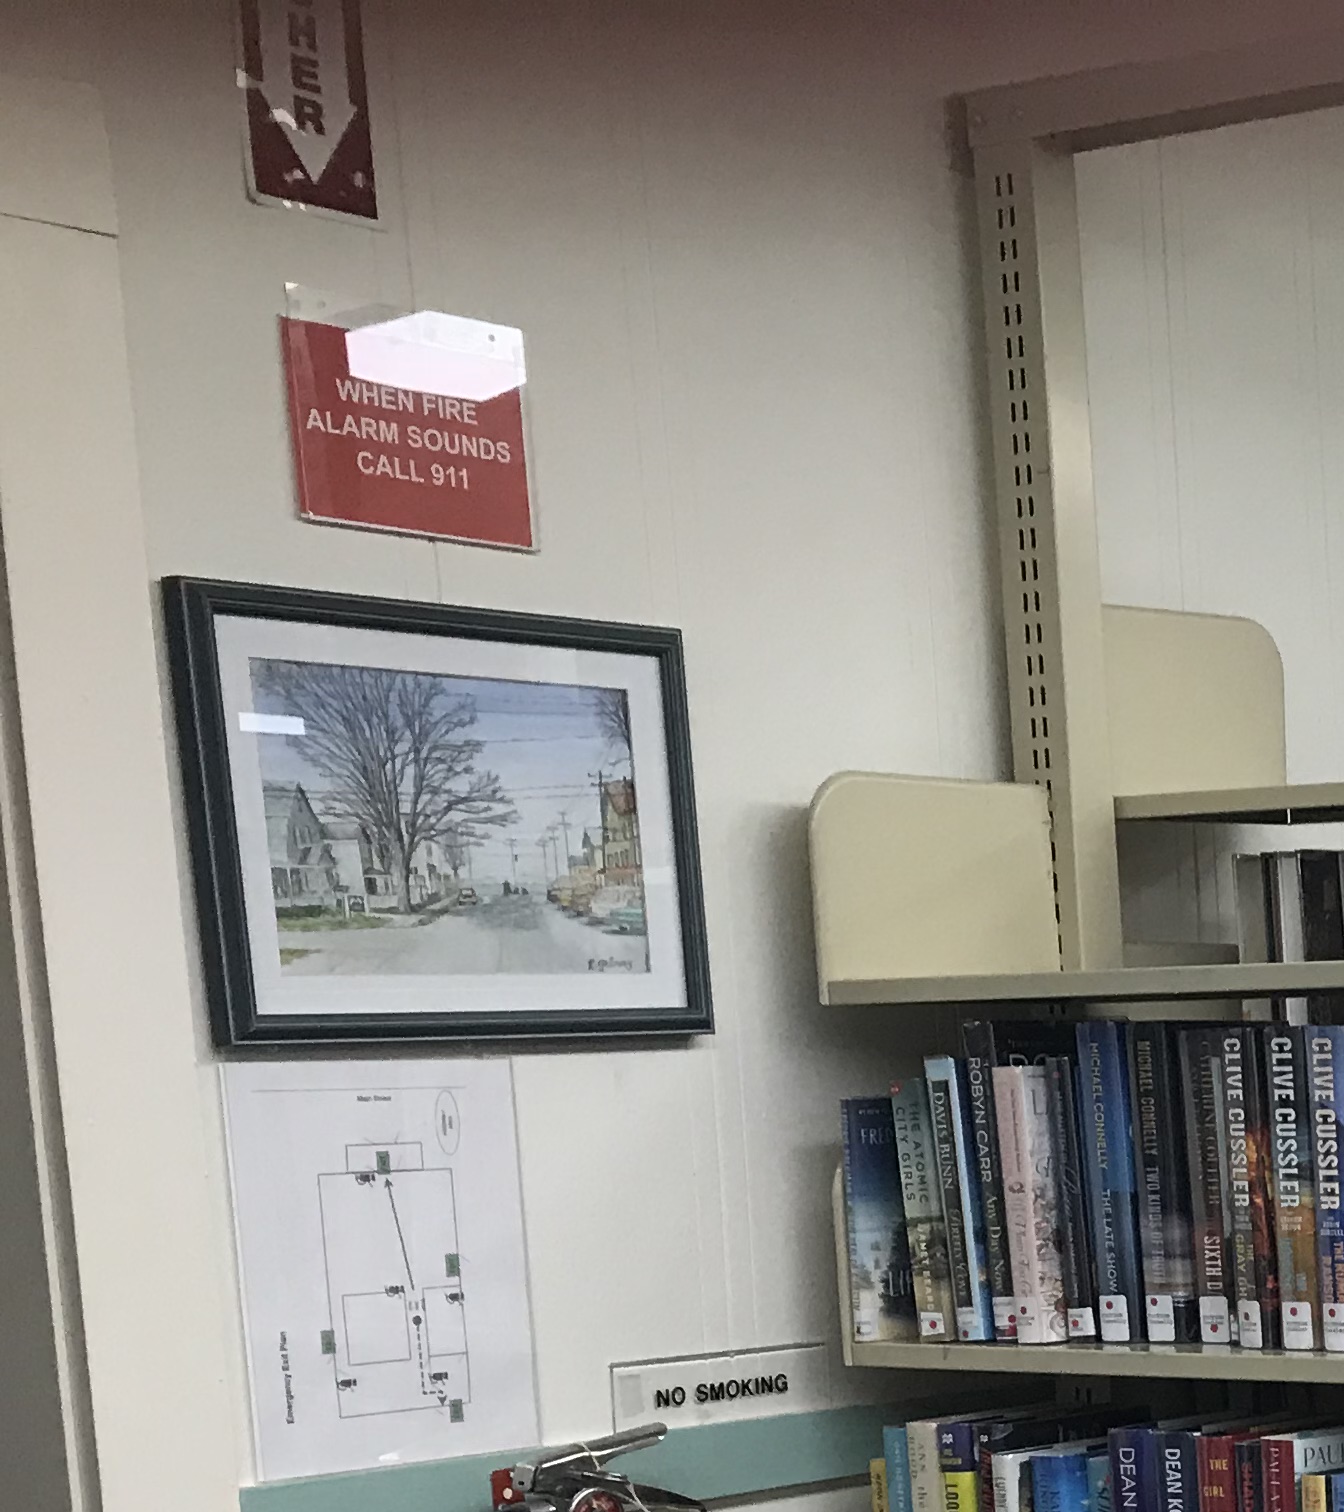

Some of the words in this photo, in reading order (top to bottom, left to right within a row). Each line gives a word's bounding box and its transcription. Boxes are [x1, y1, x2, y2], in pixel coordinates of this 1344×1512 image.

[336, 377, 415, 414] WHEN
[422, 394, 477, 425] FIRE
[307, 407, 399, 445] ALARM
[407, 426, 511, 464] SOUNDS
[357, 451, 424, 484] CALL
[430, 464, 469, 489] 911
[1223, 1037, 1244, 1101] CLIVE
[1270, 1036, 1295, 1101] CLIVE
[1311, 1037, 1334, 1102] CLIVE
[976, 1130, 992, 1183] CARR
[1228, 1108, 1250, 1207] CUSSLER
[1275, 1107, 1300, 1207] CUSSLER
[1315, 1109, 1339, 1210] CUSSLER
[656, 1387, 685, 1408] NO
[695, 1373, 789, 1404] SMOKING
[1119, 1447, 1136, 1507] DEAN
[1165, 1449, 1183, 1494] DEAN
[1209, 1459, 1228, 1471] THE
